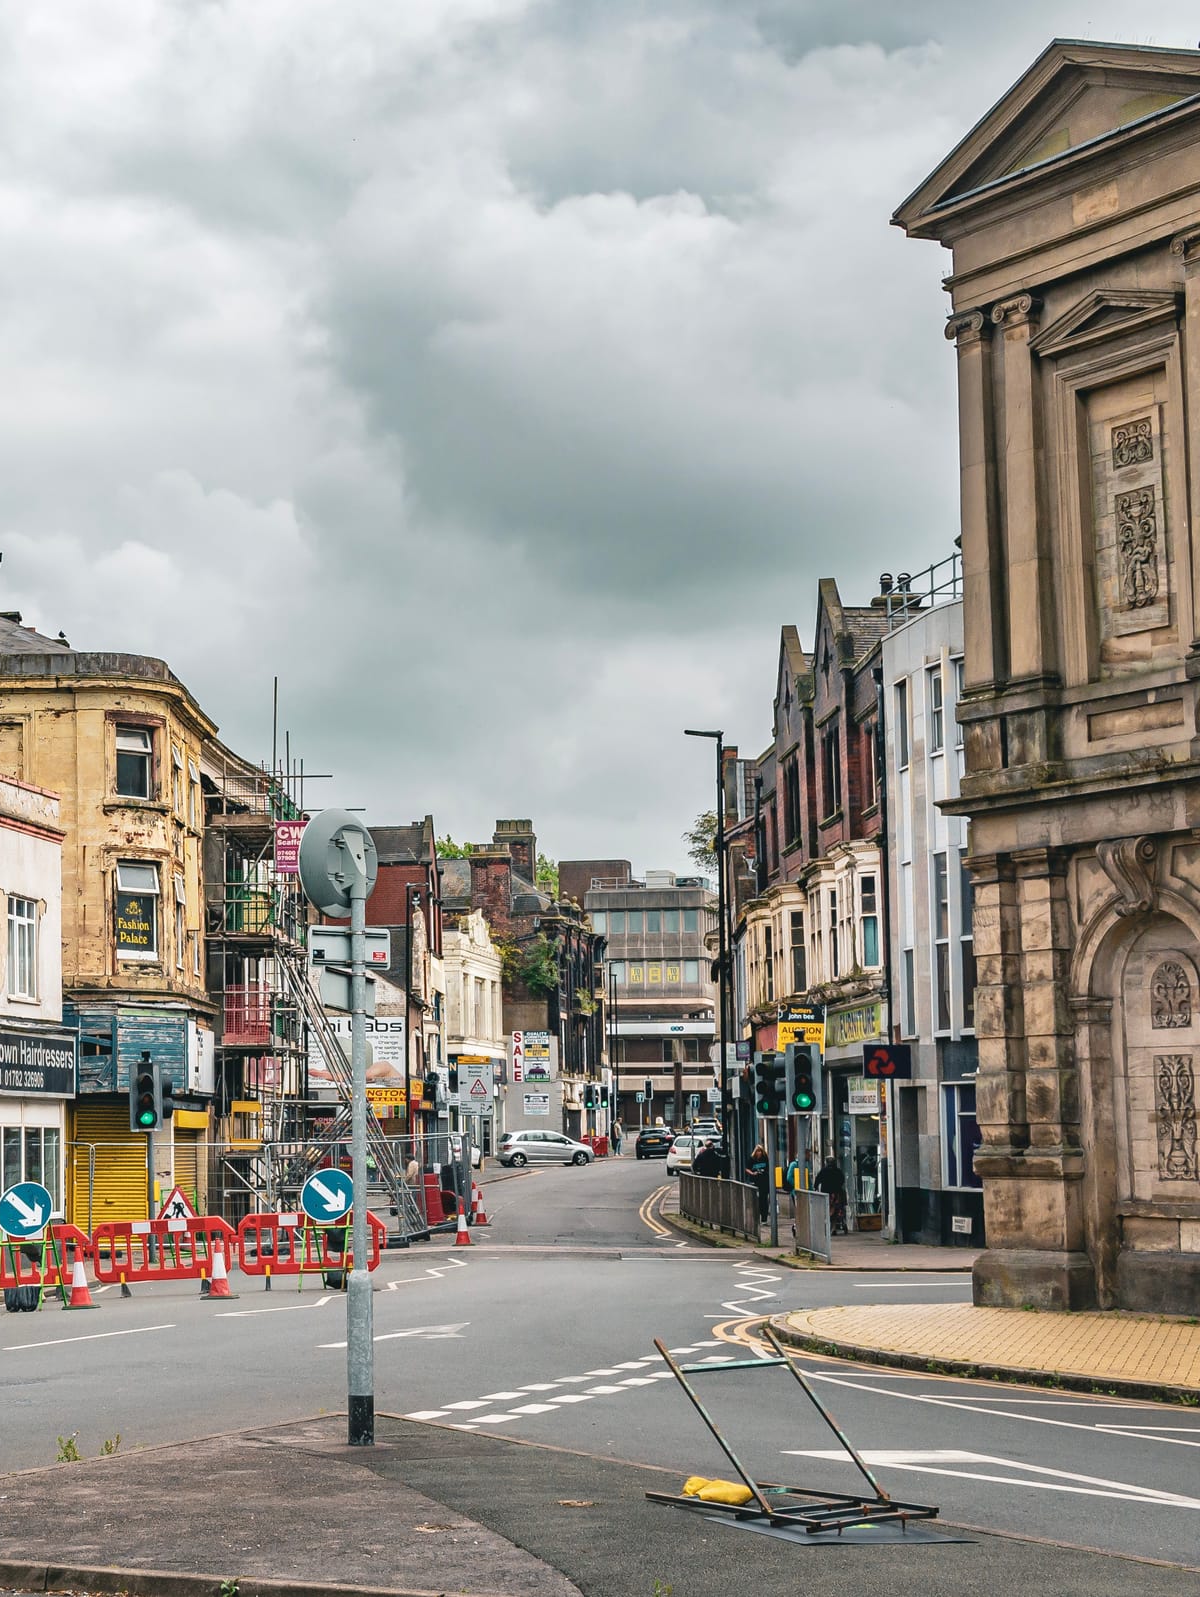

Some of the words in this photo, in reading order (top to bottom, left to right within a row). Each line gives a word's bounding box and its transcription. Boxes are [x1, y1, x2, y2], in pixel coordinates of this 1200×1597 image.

[277, 826, 304, 839] CW
[118, 918, 150, 930] Fashion
[120, 932, 148, 945] Palace
[788, 1012, 803, 1020] john
[19, 1039, 74, 1070] Hairdressers
[513, 1032, 522, 1082] SALE
[4, 1069, 23, 1087] 01782
